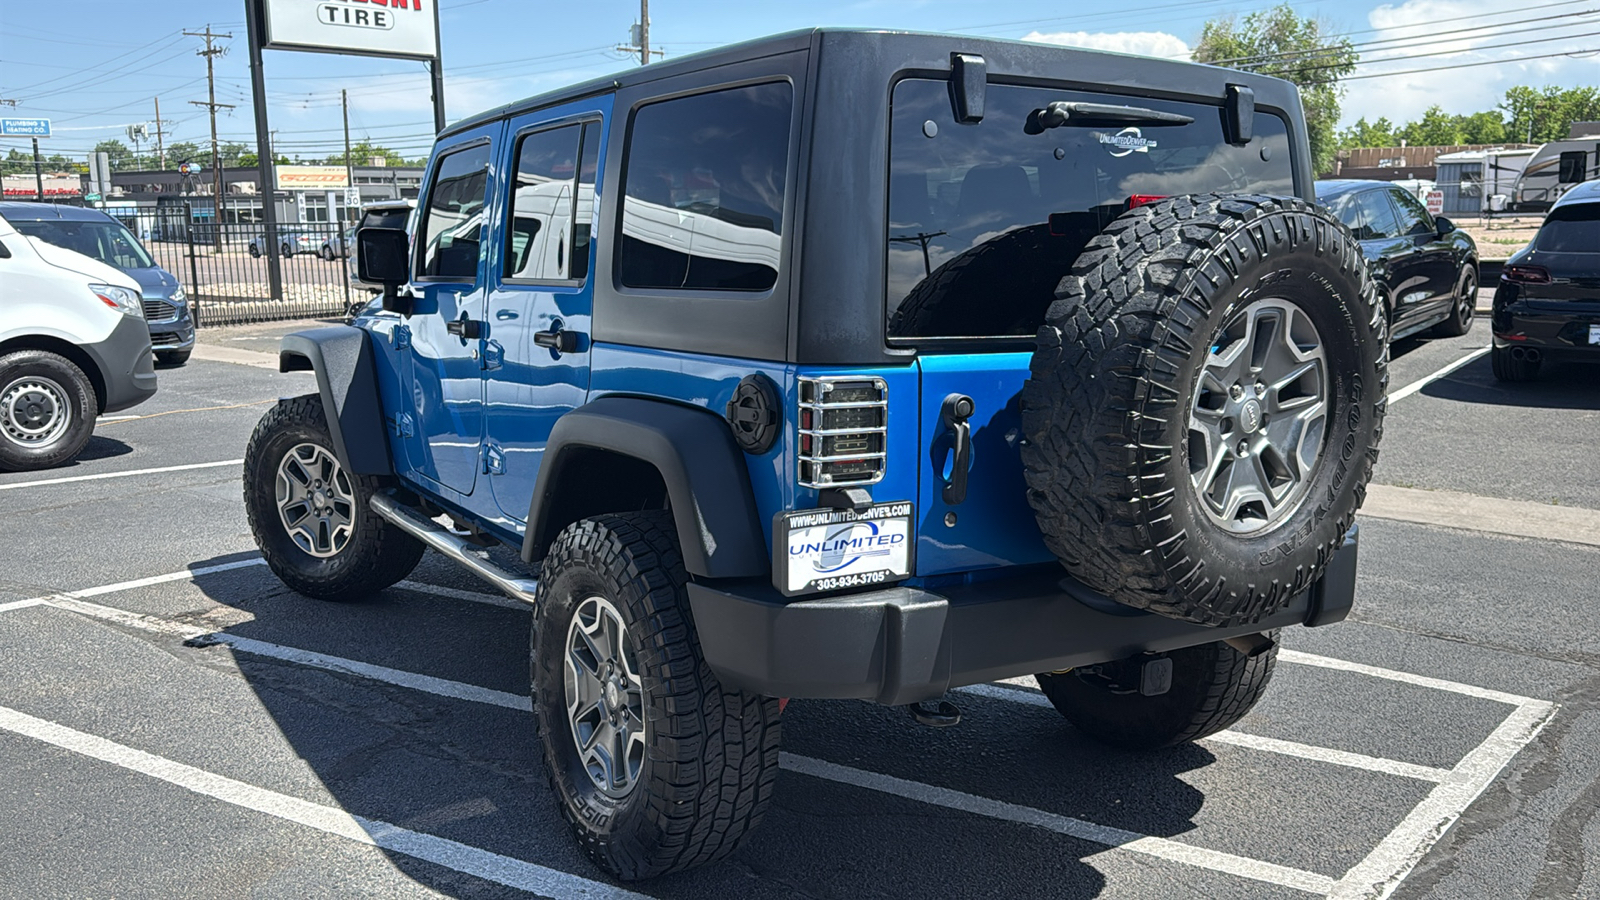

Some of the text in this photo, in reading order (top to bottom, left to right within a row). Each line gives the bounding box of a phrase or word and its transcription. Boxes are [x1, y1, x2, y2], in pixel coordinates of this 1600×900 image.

[324, 6, 386, 27] TIRE
[346, 197, 359, 205] 30
[1258, 373, 1364, 567] GOODYEAR
[789, 533, 905, 556] UNLIMITED
[816, 571, 885, 591] 303-934-3705
